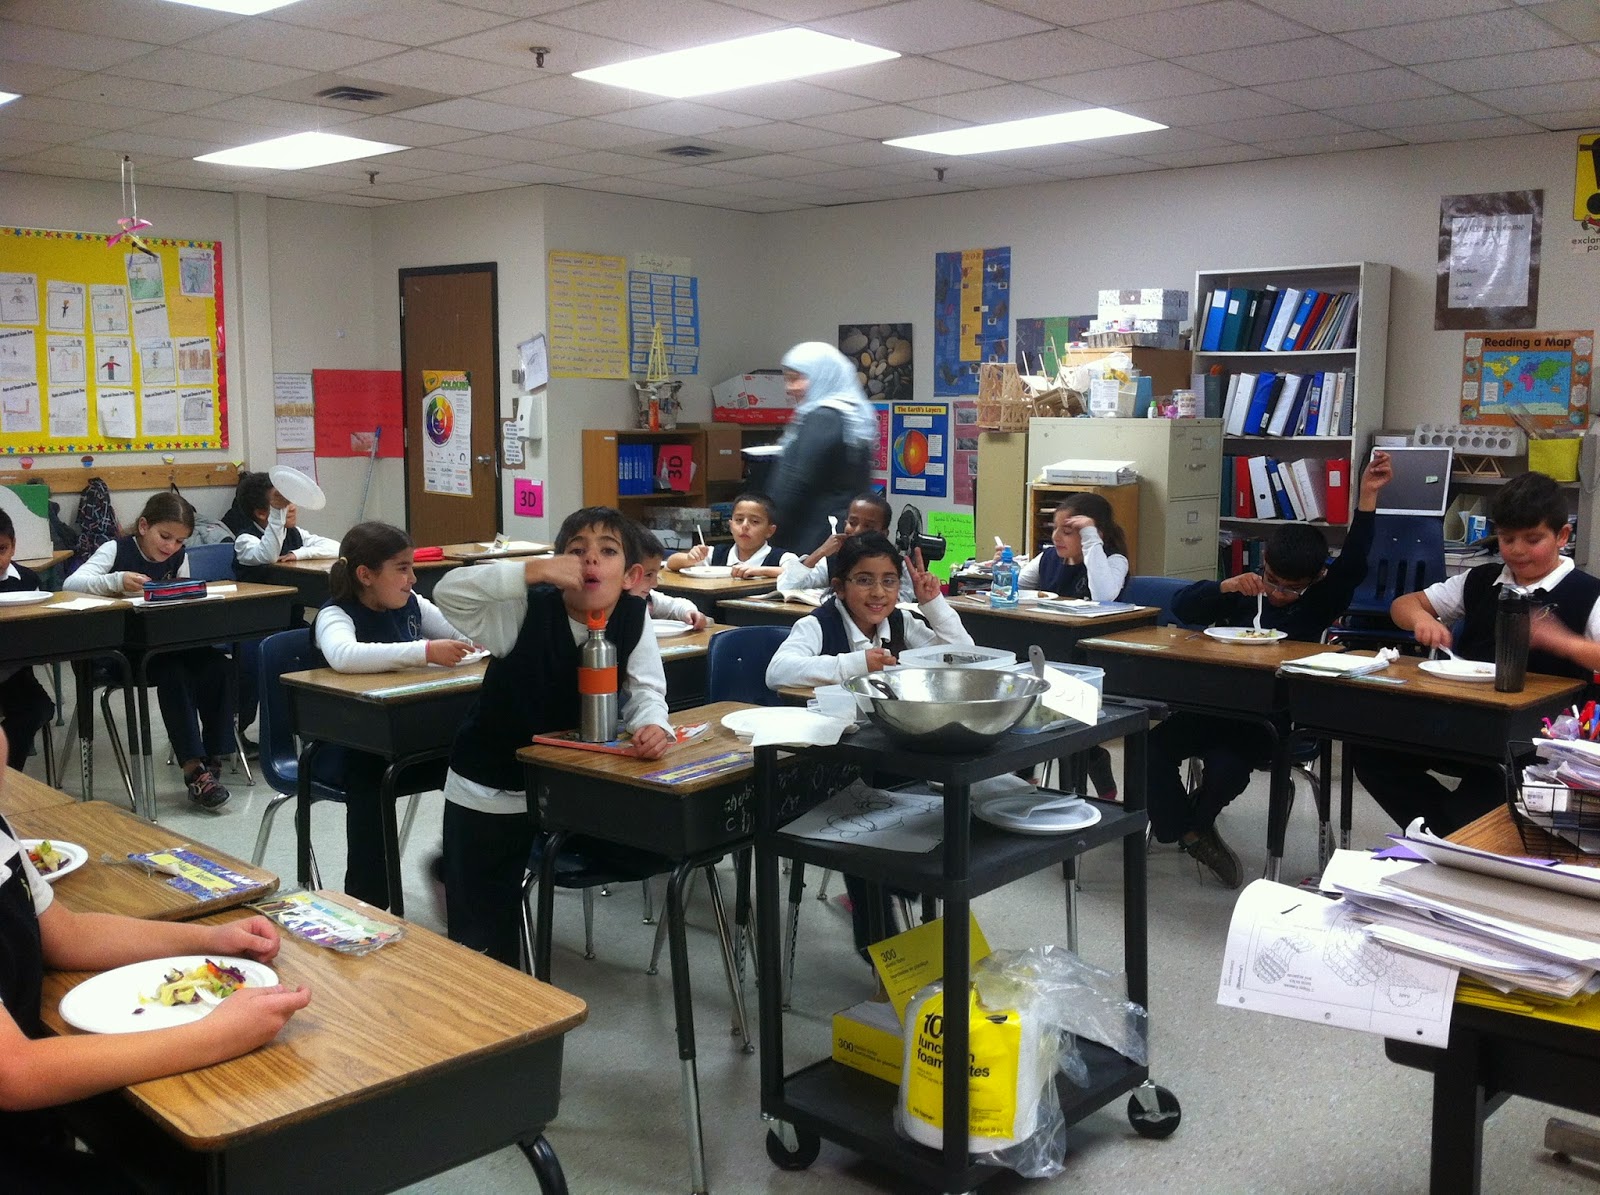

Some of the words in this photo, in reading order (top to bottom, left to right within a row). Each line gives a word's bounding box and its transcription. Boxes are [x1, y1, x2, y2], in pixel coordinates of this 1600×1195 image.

[1484, 338, 1530, 349] Reading
[1545, 338, 1571, 348] Map
[668, 456, 682, 479] 3D
[520, 491, 536, 507] 3D
[880, 949, 896, 962] 300
[924, 1013, 944, 1039] 10
[838, 1038, 853, 1052] 300
